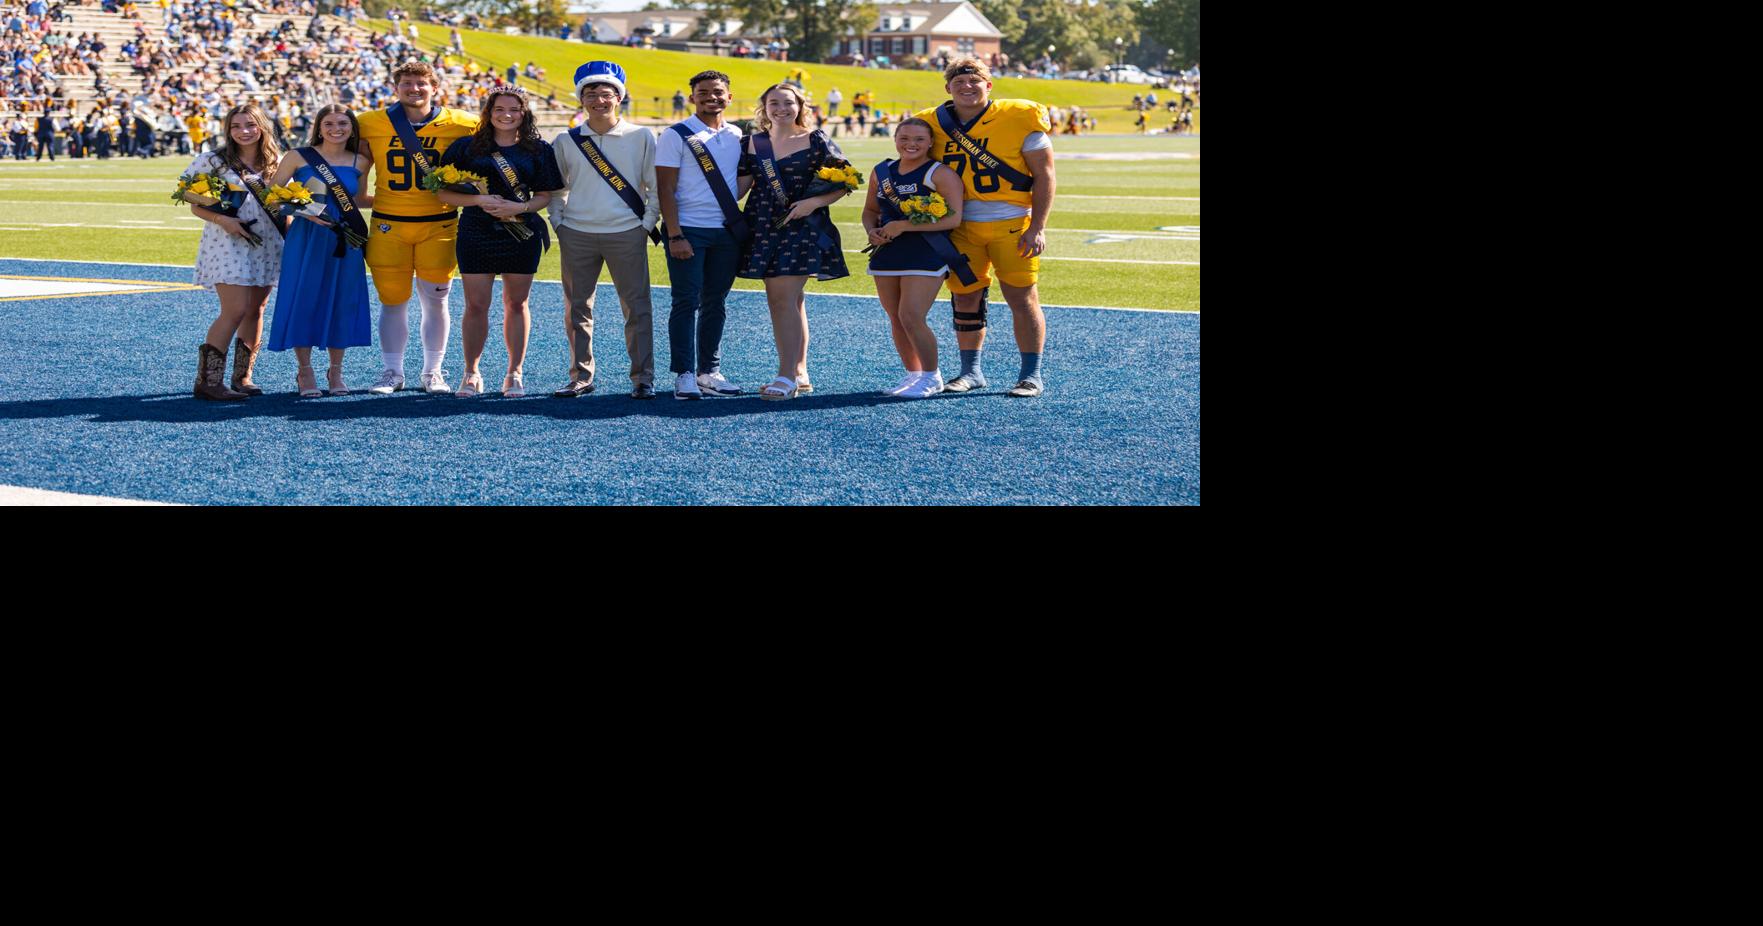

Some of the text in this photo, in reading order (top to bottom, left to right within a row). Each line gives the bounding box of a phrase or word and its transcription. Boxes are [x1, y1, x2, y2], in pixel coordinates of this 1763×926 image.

[581, 140, 627, 191] HOMECOMING KING
[699, 154, 715, 172] DUKE
[761, 159, 776, 178] JUNIOR
[952, 128, 999, 169] FRESHMAN DUKE
[316, 163, 353, 212] SENIOR DUCHESS
[943, 154, 1000, 193] 78
